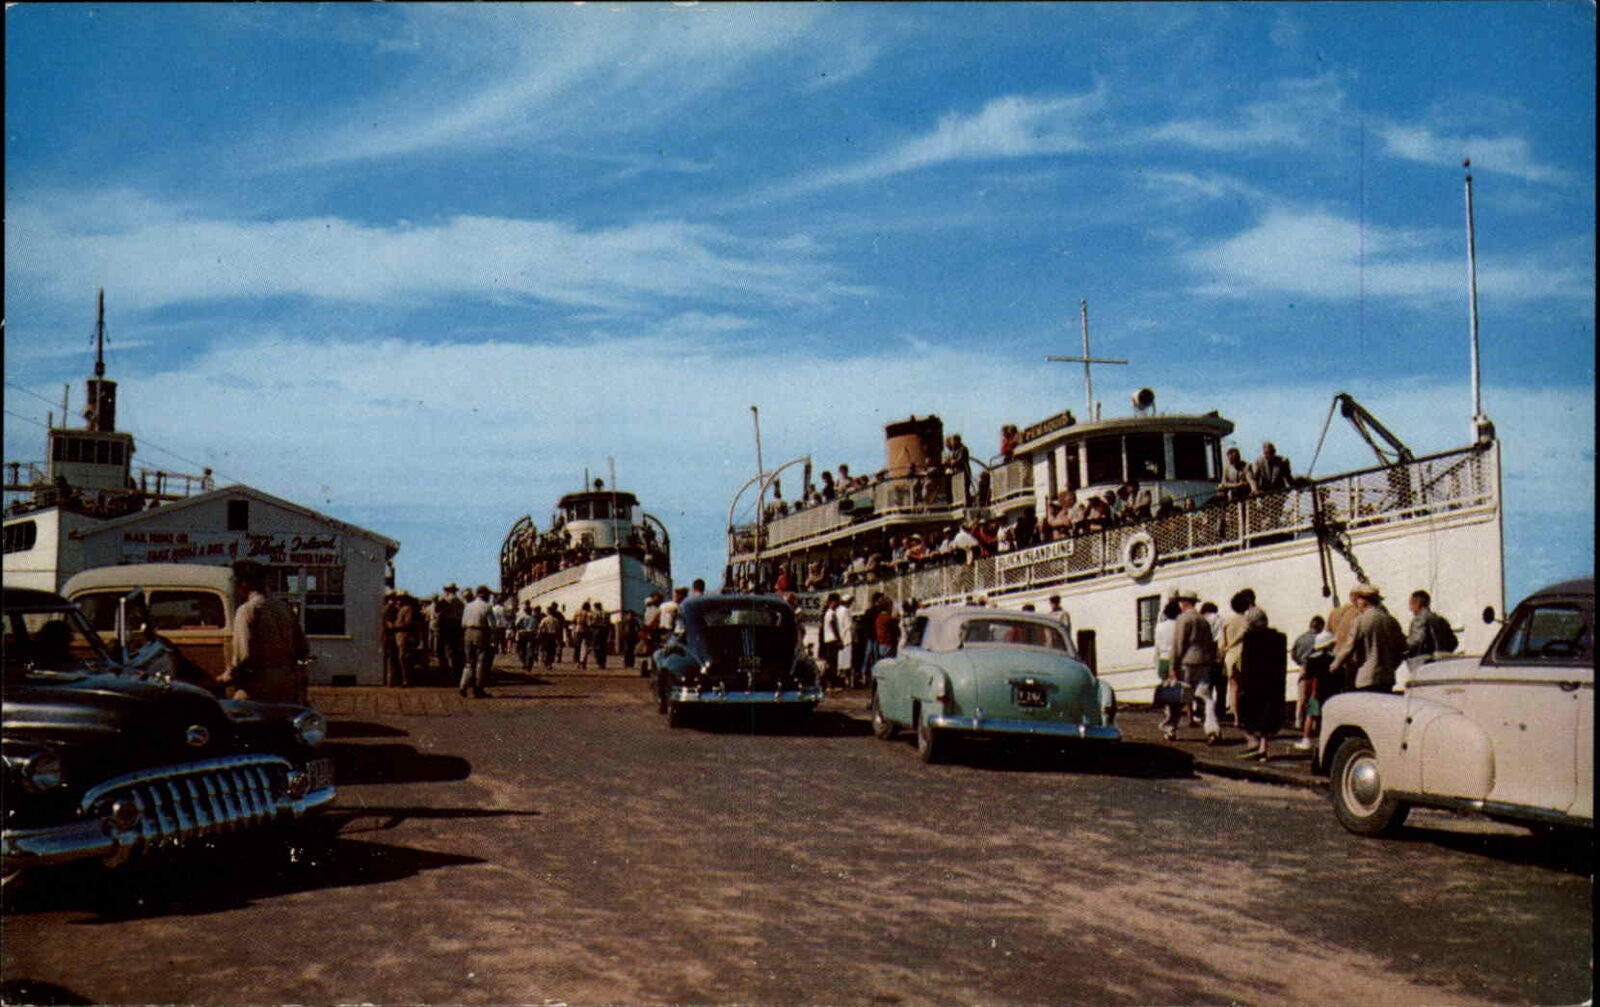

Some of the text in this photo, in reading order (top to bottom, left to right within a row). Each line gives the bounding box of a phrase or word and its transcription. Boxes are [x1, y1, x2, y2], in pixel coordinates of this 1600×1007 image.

[291, 535, 336, 551] Island
[1022, 545, 1052, 565] ISLAND
[1052, 541, 1073, 557] LINE
